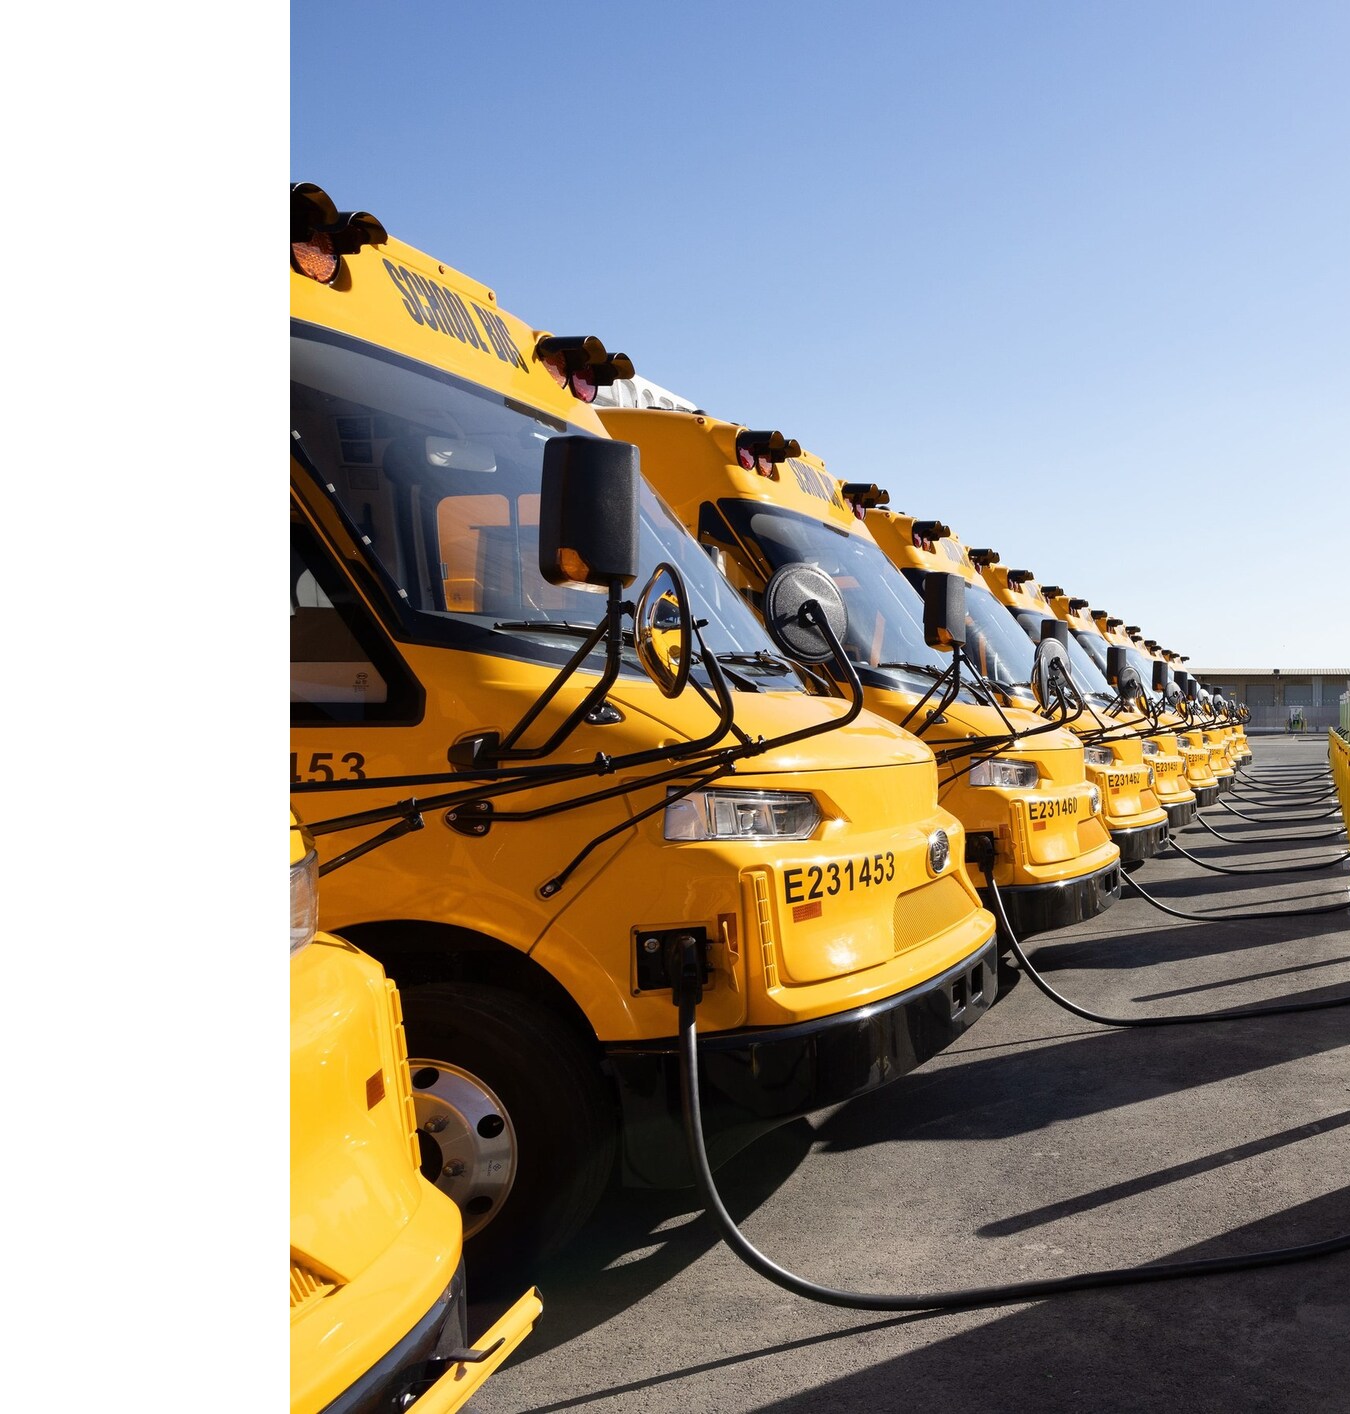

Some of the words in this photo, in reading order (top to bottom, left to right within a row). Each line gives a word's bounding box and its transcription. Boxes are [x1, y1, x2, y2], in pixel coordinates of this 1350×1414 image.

[382, 258, 491, 354] SCHOOL
[470, 301, 530, 374] BUS
[1028, 796, 1078, 820] E231460
[784, 851, 895, 904] E231453
